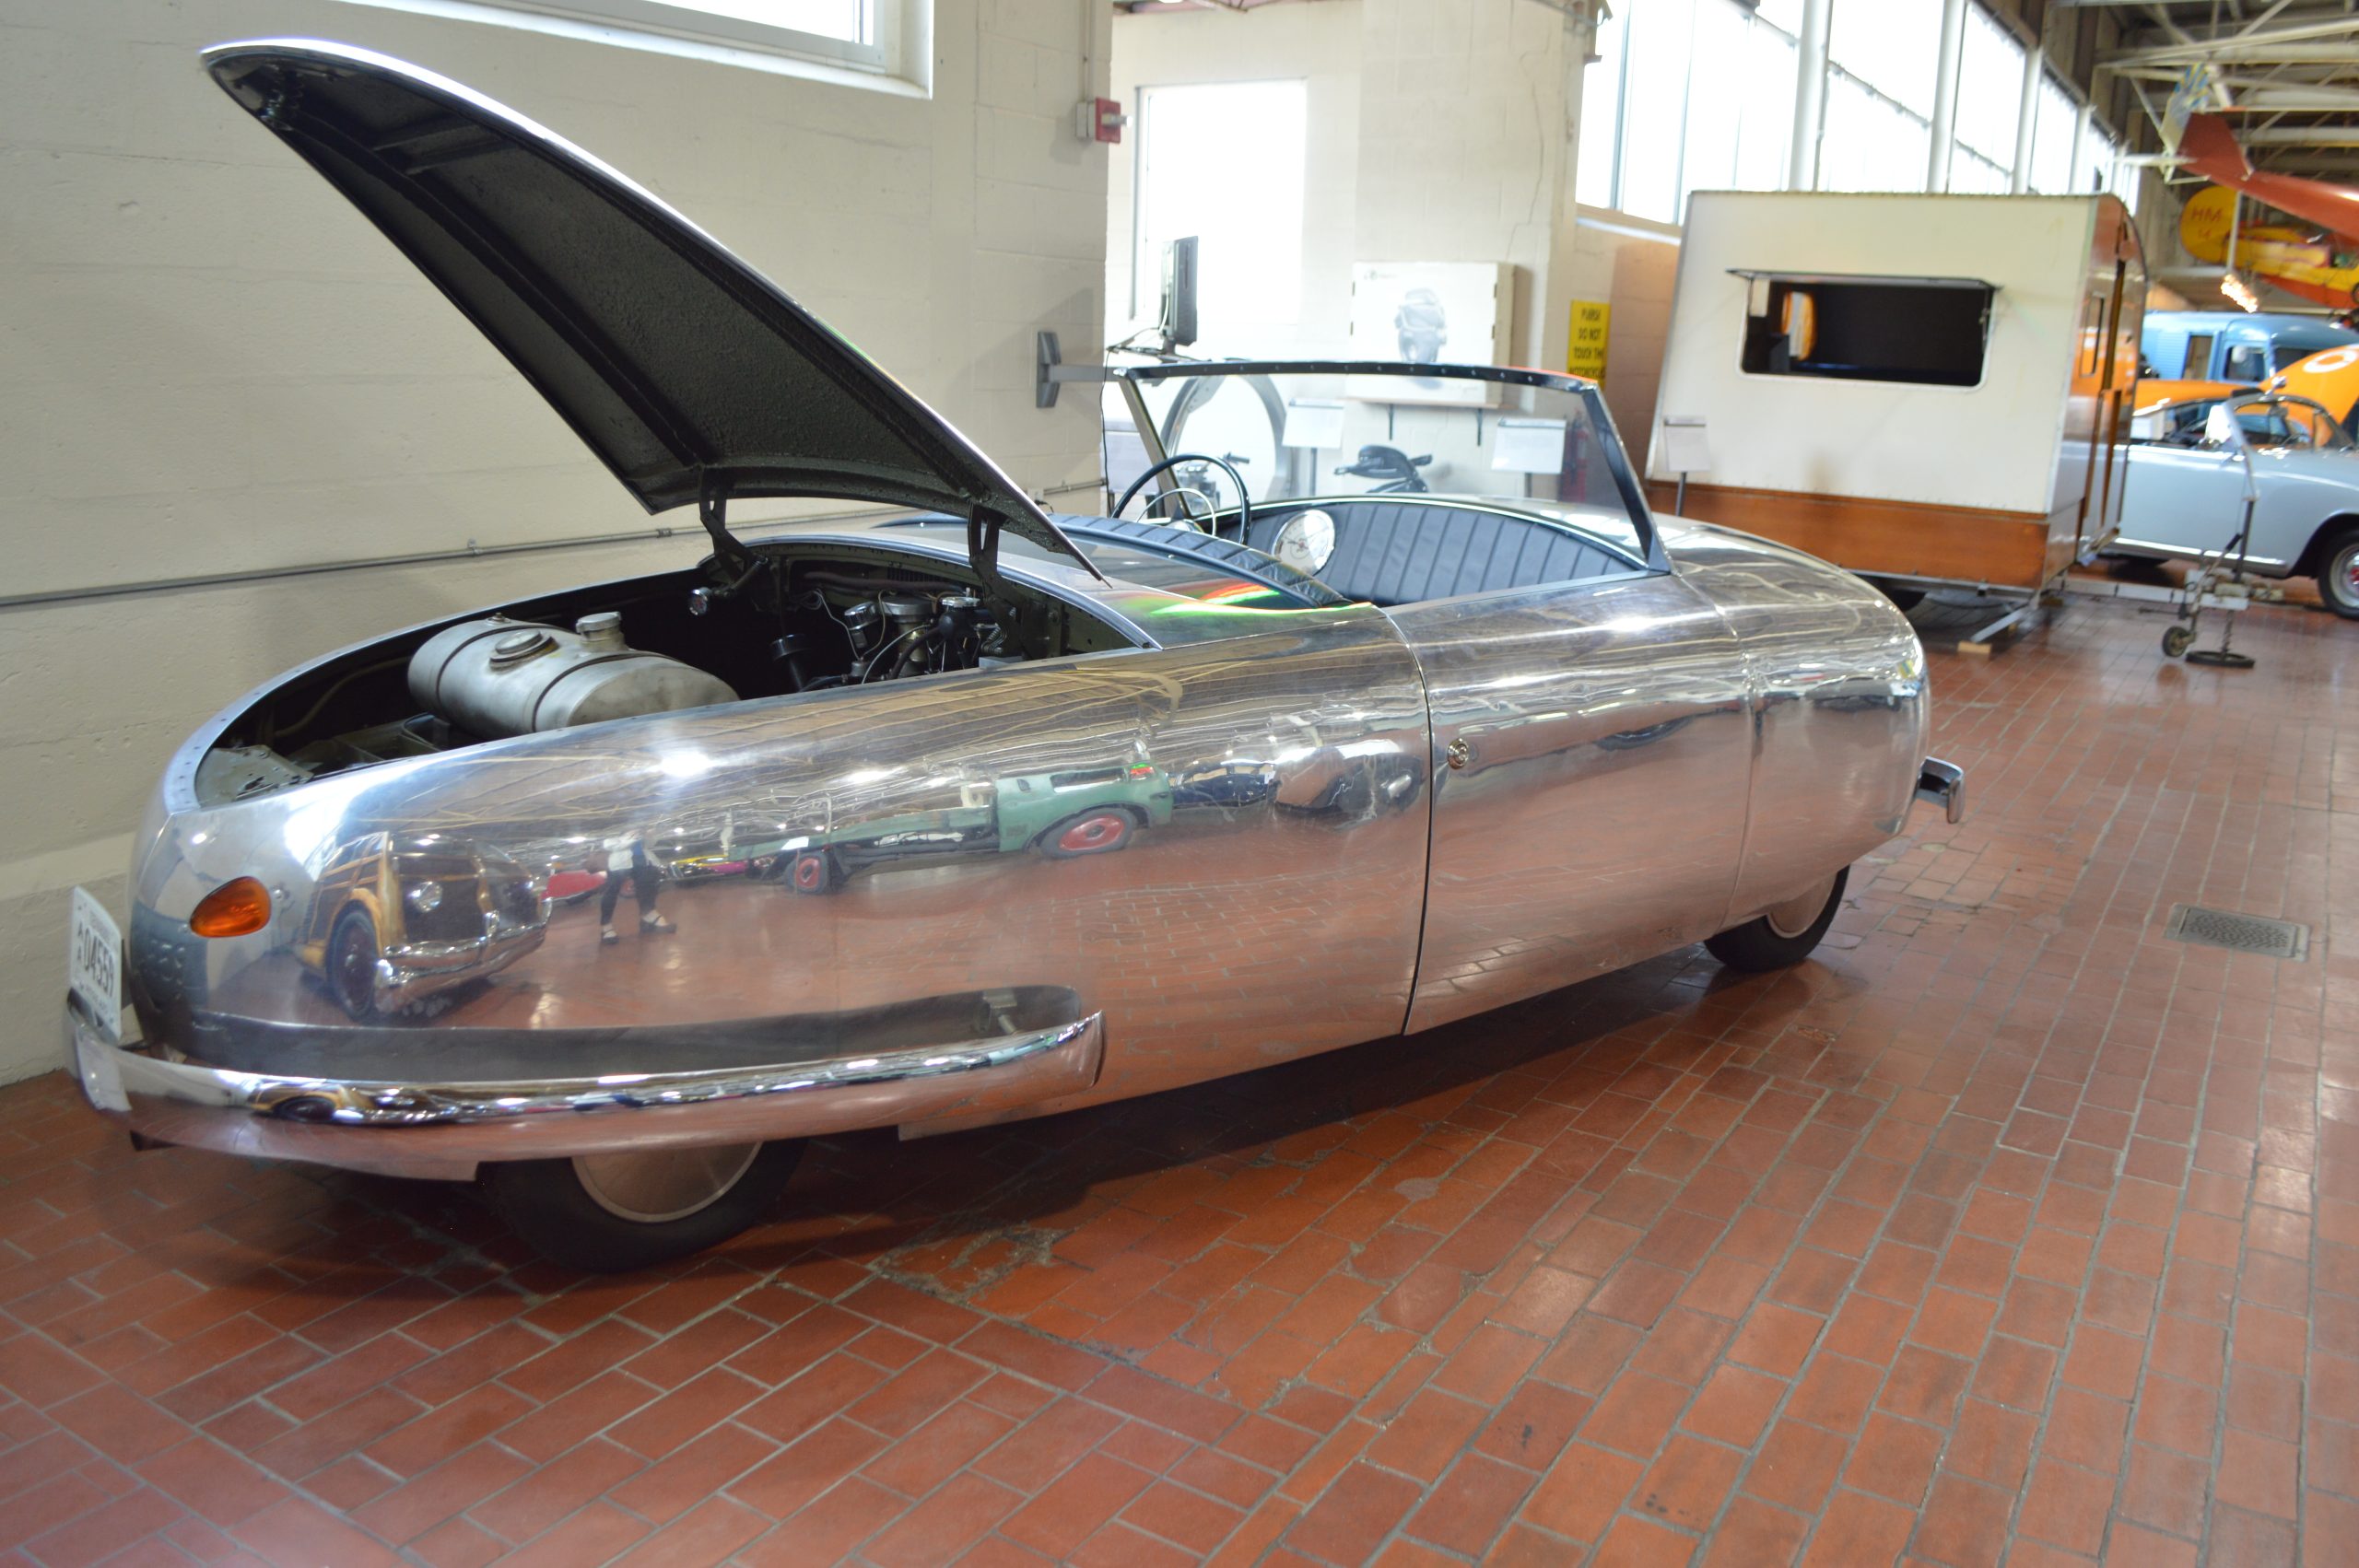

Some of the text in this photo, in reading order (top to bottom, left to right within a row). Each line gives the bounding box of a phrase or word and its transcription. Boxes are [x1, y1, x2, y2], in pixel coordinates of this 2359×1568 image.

[2190, 206, 2224, 222] HM
[1578, 327, 1602, 340] DO NOT
[1574, 345, 1592, 359] TOUCH
